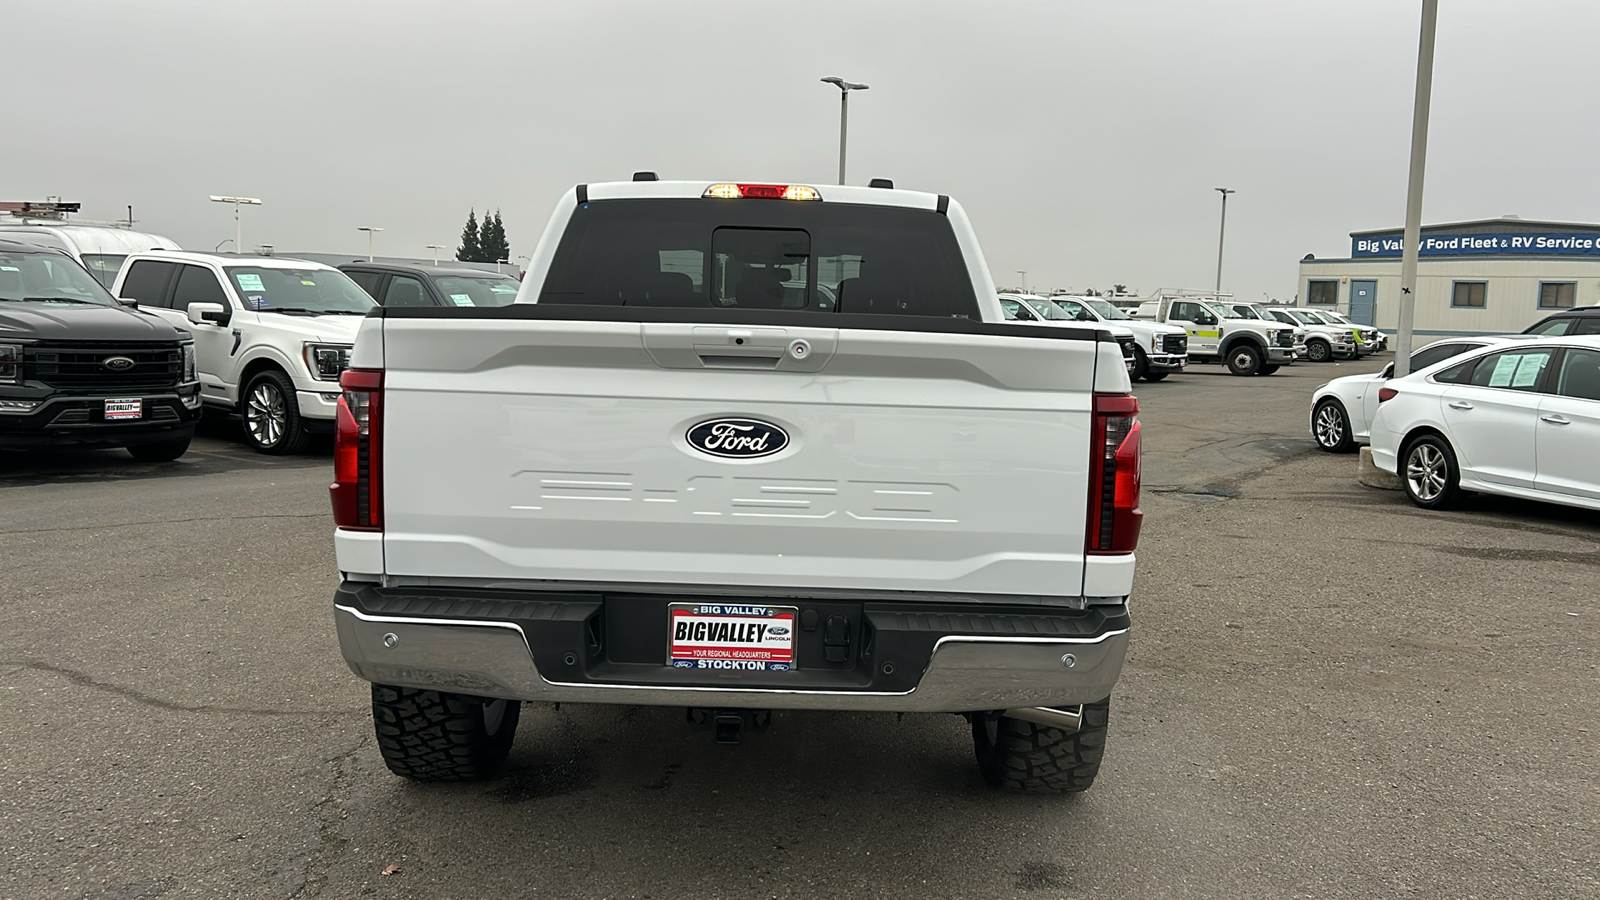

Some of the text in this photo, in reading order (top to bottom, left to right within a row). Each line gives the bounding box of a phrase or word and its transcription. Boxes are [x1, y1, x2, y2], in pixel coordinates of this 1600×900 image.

[1358, 240, 1380, 253] Big
[1382, 239, 1425, 252] Valy
[1426, 237, 1459, 250] Ford
[1461, 237, 1498, 249] Fleet
[1500, 239, 1509, 248] &
[1511, 236, 1534, 248] RV
[1535, 236, 1593, 249] Service
[704, 423, 770, 451] Ford
[700, 606, 767, 616] BIG VALLEY
[674, 621, 768, 643] BIGVALLEY
[708, 650, 731, 658] REGIONAL
[732, 651, 771, 659] HEADQUARTERS
[697, 659, 766, 671] STOCKTON
